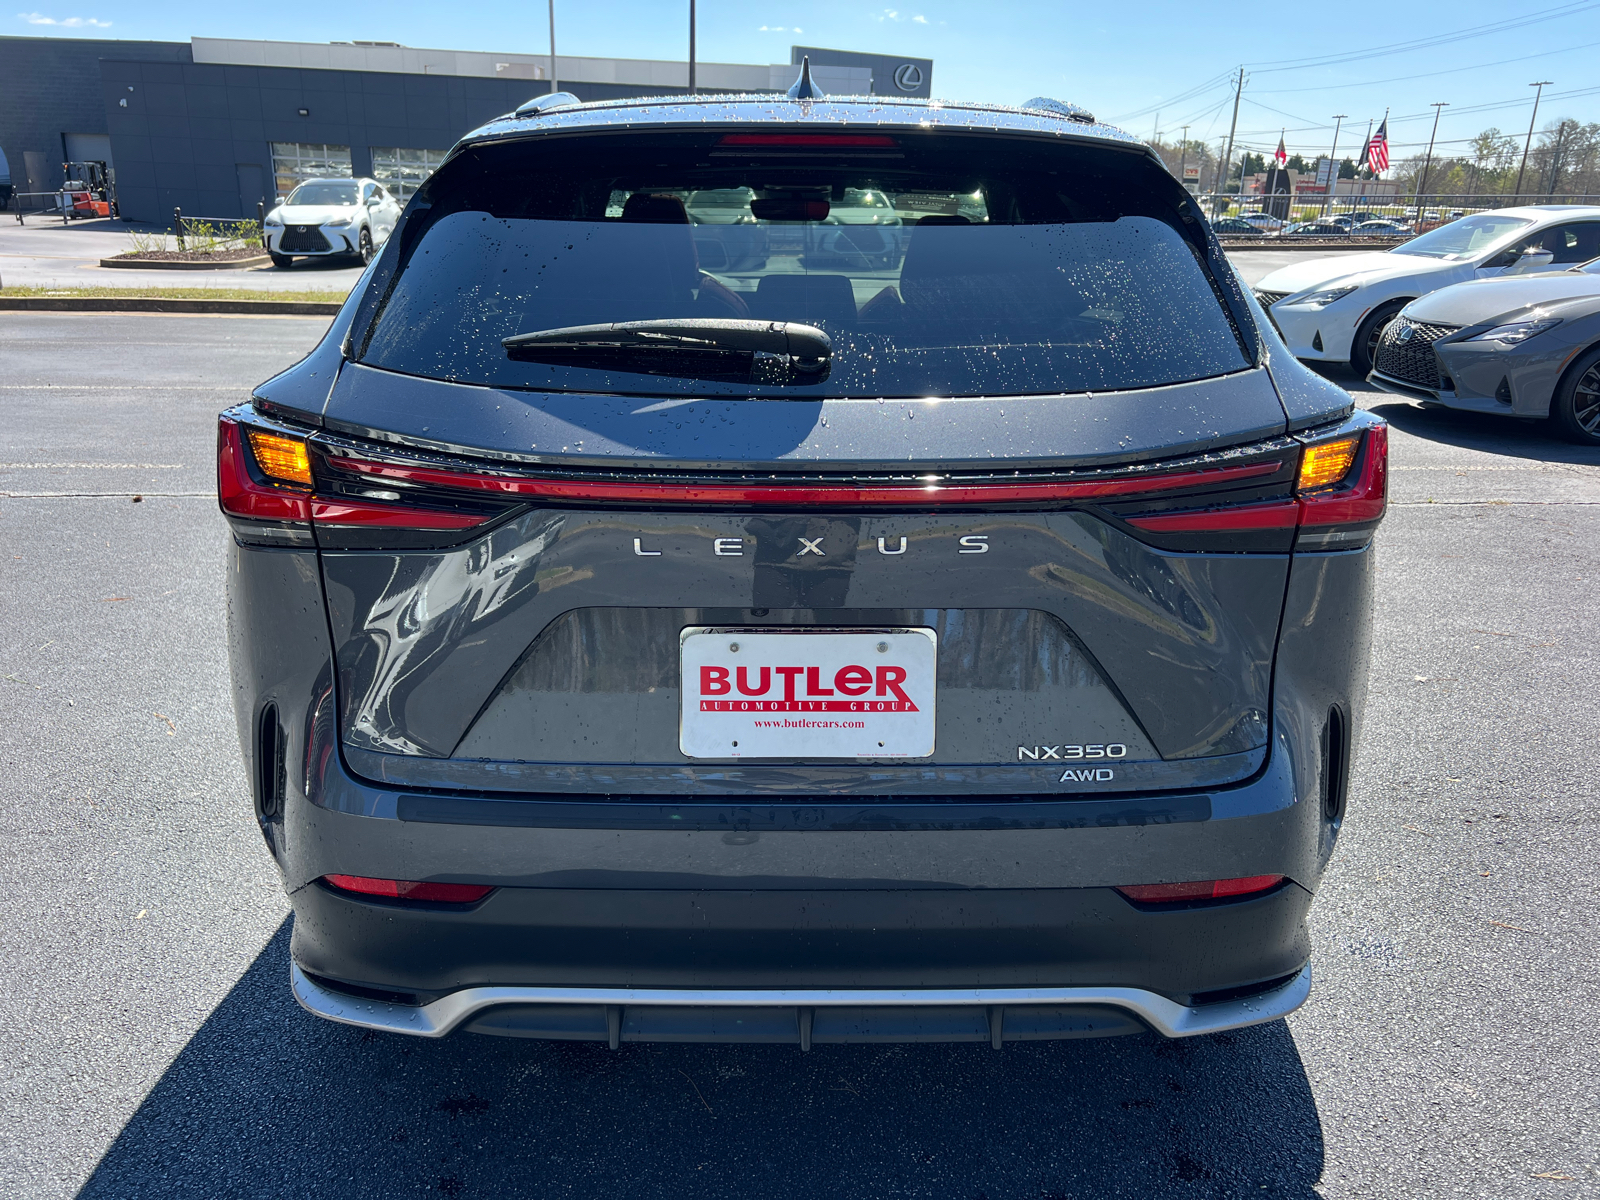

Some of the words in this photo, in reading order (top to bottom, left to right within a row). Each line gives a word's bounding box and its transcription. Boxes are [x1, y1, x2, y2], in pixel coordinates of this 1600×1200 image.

[633, 534, 990, 557] LEXUS
[701, 701, 828, 711] AUTOMOTIVE
[849, 701, 912, 711] GROUP
[754, 718, 865, 729] www.butlercars.com
[1059, 768, 1114, 782] AWD
